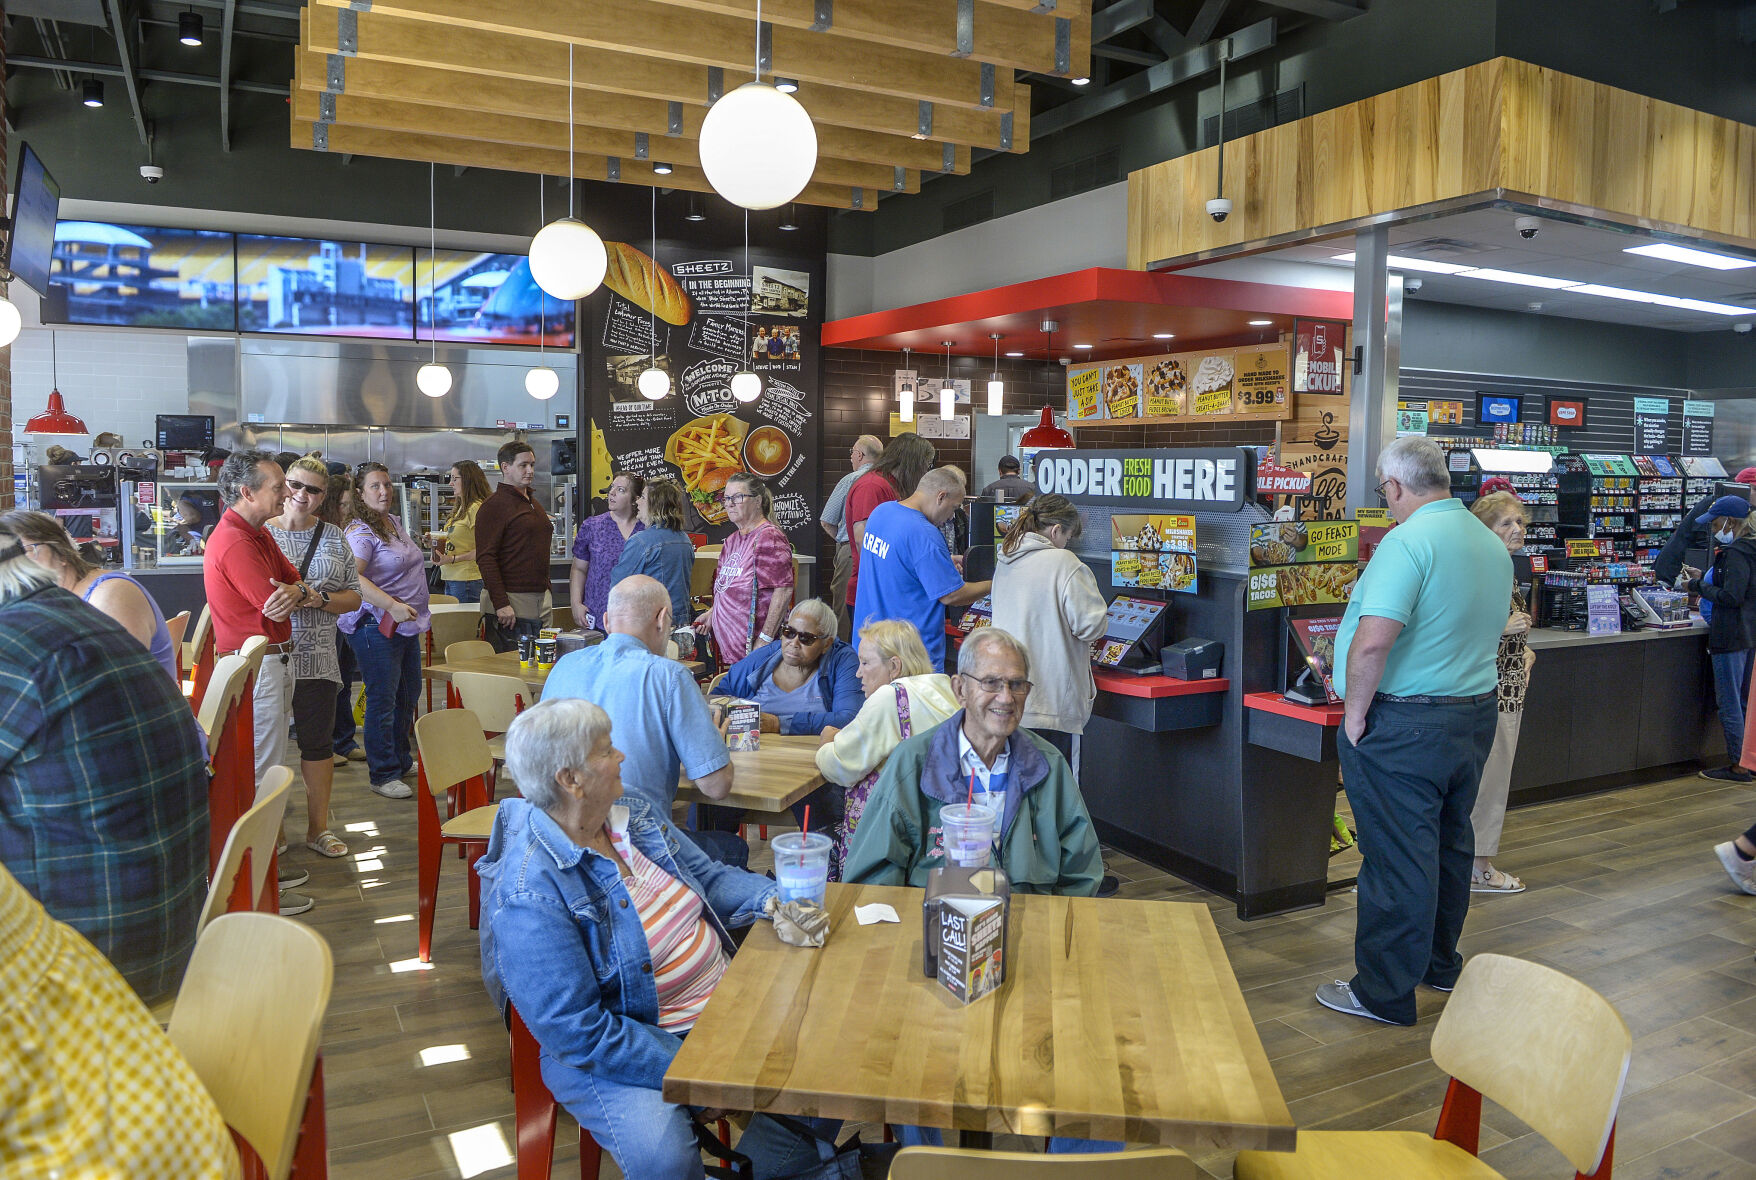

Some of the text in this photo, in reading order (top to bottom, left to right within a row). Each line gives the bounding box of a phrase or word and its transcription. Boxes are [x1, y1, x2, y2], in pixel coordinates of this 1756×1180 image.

[677, 263, 729, 273] SHEETZ
[689, 279, 751, 289] IN THE BEGINNING
[685, 364, 733, 383] WELCOME
[1309, 361, 1336, 374] MOBIL
[1071, 371, 1098, 387] YOU CAN'T
[1073, 384, 1099, 398] JUST TAKE
[1197, 392, 1229, 403] PEANUT BUTTER
[1085, 396, 1094, 405] SIP
[1111, 398, 1138, 410] PEANUT BUTTER
[1238, 390, 1274, 406] $3.99
[620, 456, 648, 466] TOPPINGS
[625, 451, 643, 459] OFFER
[647, 459, 663, 467] EVEN
[1124, 458, 1152, 476] FRESH
[657, 467, 668, 475] YOU
[778, 454, 806, 488] FEEL THE LOVE
[1038, 458, 1123, 496] ORDER
[1154, 459, 1236, 501] HERE
[1257, 477, 1310, 491] ILE PICKUP
[1124, 477, 1151, 497] FOOD
[773, 499, 800, 511] USTOMIZE
[1311, 525, 1354, 543] GO FEAST
[863, 531, 890, 560] CREW
[1165, 539, 1188, 550] $3.99
[1318, 544, 1342, 557] MODE
[1250, 573, 1277, 591] 6/$6
[1251, 590, 1276, 601] TACOS
[729, 711, 759, 720] SHEETZ
[941, 911, 966, 932] LAST
[942, 928, 967, 949] CALL!
